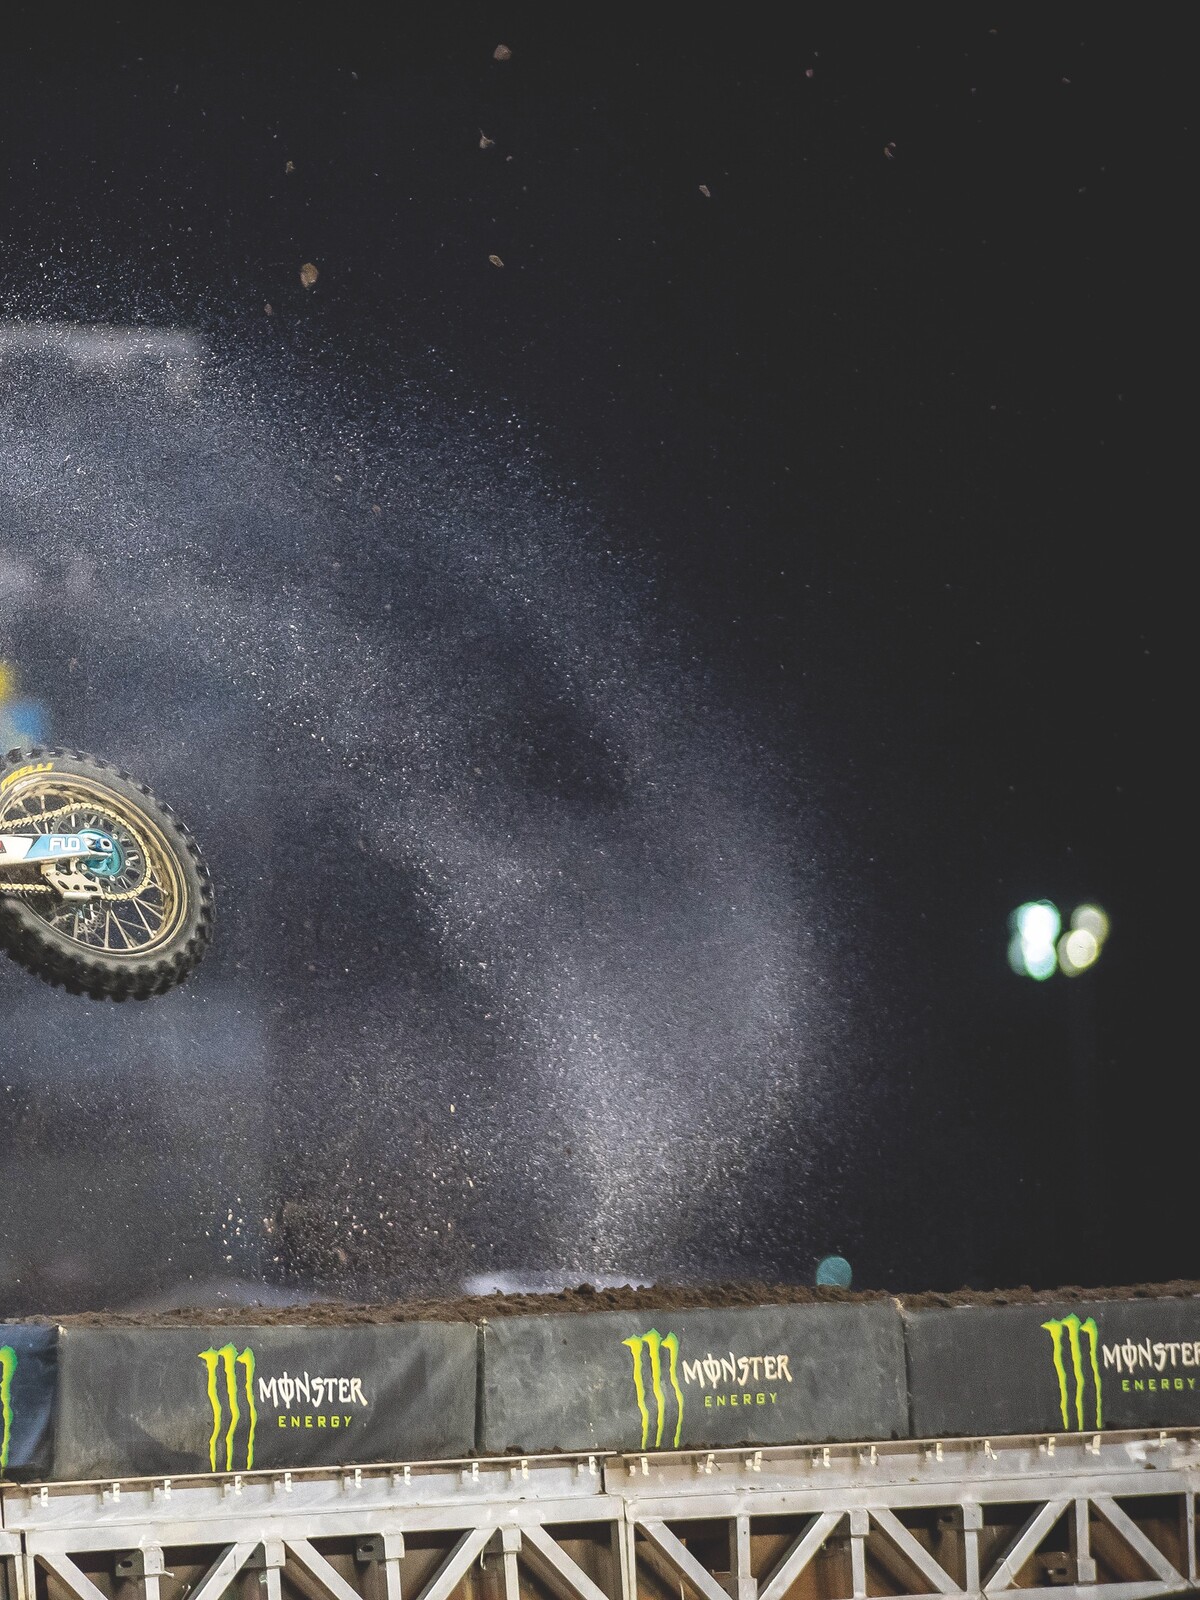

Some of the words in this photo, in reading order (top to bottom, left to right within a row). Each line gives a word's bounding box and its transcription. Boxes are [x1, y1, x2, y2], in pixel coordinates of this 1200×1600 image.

[49, 837, 81, 852] FLO
[682, 1351, 793, 1389] MONSTER
[258, 1371, 368, 1409] MONSTER
[1121, 1377, 1196, 1392] ENERGY
[704, 1392, 778, 1408] ENERGY
[278, 1415, 352, 1428] ENERGY
